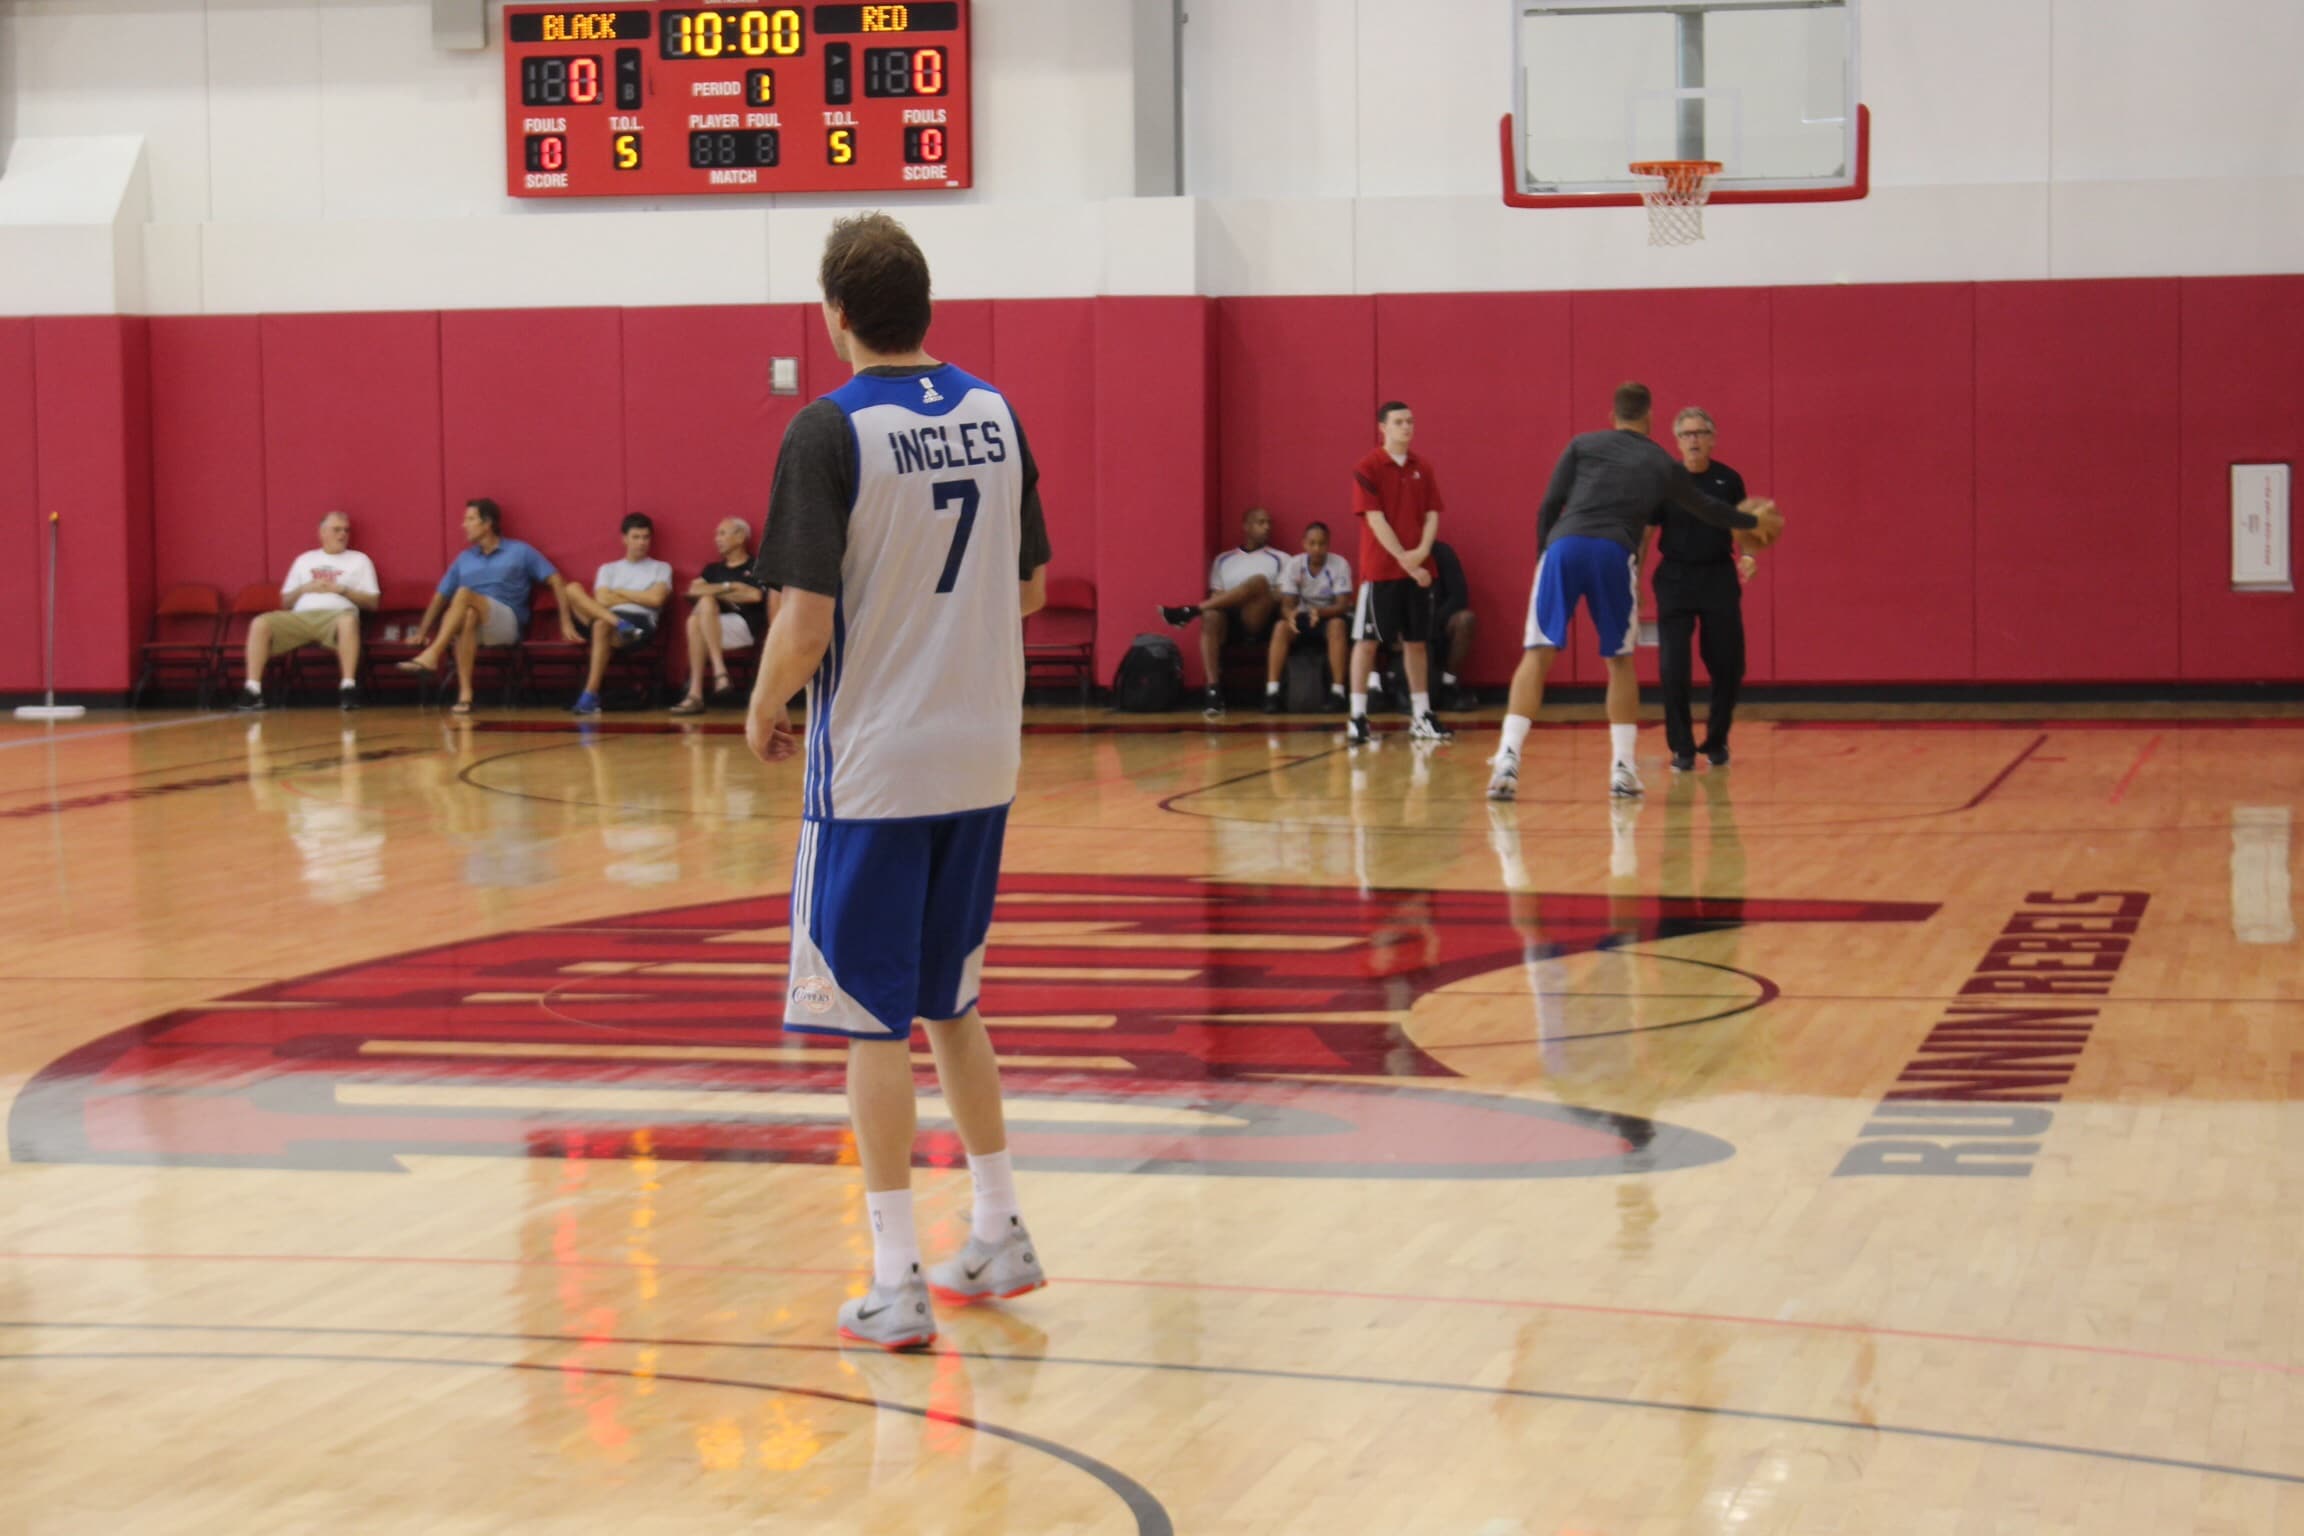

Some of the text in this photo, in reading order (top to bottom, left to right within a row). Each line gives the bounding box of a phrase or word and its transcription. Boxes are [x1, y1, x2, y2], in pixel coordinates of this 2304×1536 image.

[543, 13, 616, 40] BLACK
[862, 5, 908, 31] RED
[681, 10, 800, 56] 10:00
[692, 82, 741, 96] PERIOD
[524, 118, 567, 132] FOULS
[689, 113, 781, 128] PLAYER FOUL
[903, 109, 946, 123] FOULS
[616, 135, 638, 168] 5
[829, 130, 851, 163] 5
[525, 173, 568, 189] SCORE
[710, 170, 757, 184] MATCH
[902, 165, 947, 180] SCORE
[888, 420, 1006, 475] INGLES
[932, 478, 981, 594] 7
[1957, 891, 2151, 995] REBELS
